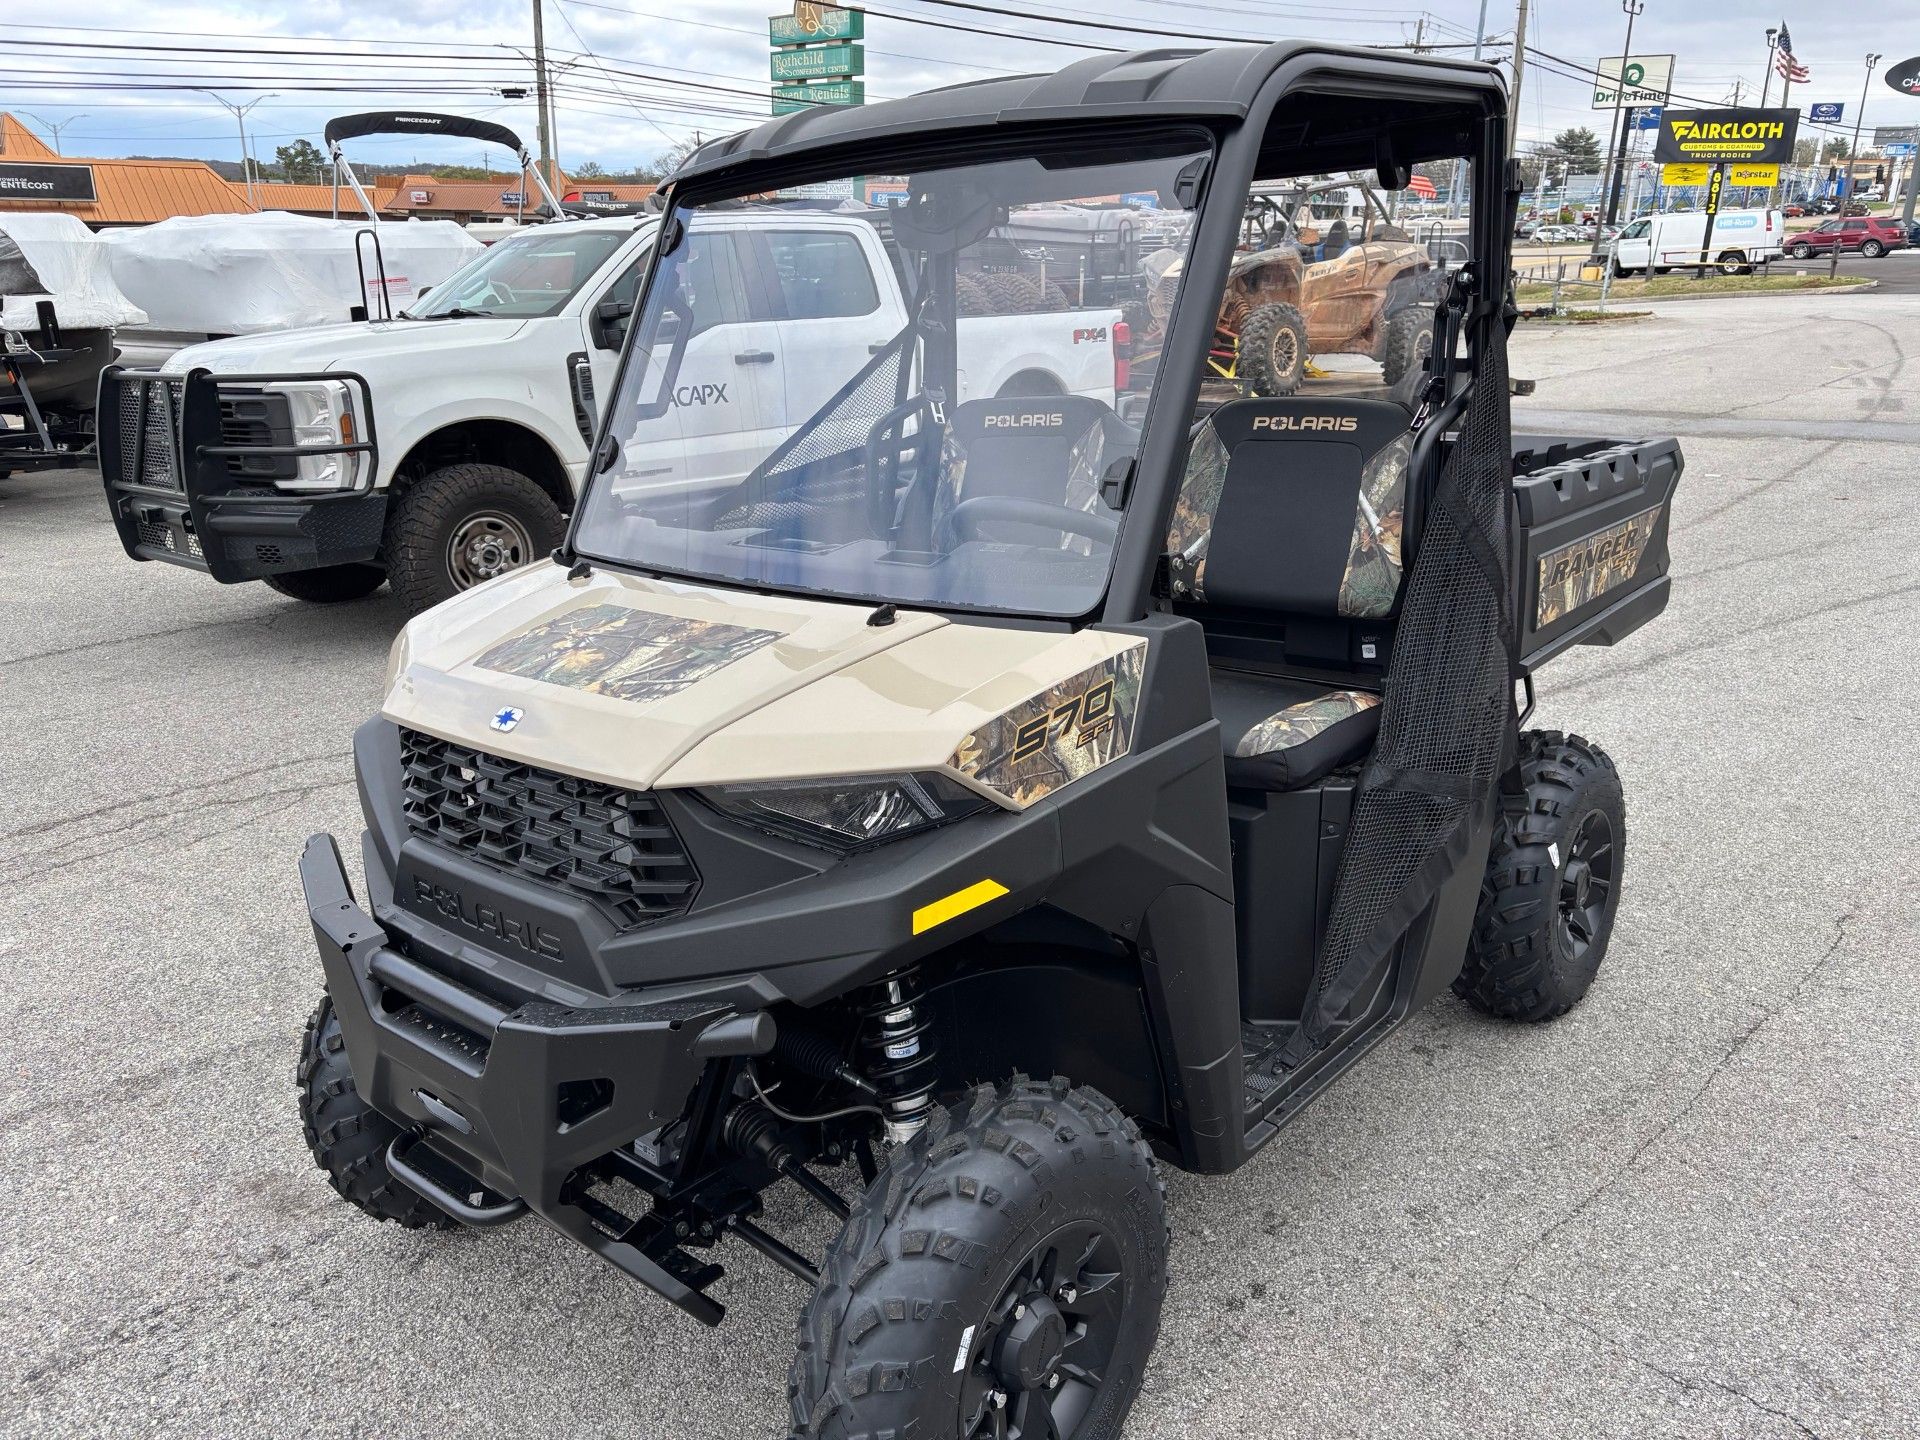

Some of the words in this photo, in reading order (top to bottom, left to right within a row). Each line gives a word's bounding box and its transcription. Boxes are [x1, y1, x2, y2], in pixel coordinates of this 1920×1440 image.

[773, 51, 824, 72] Rothchild
[793, 67, 826, 76] CONFERENCE
[828, 65, 848, 73] CENTER
[808, 85, 849, 101] Rentals
[1671, 121, 1784, 141] FAIRCLOTH
[1706, 172, 1722, 214] 8812
[585, 201, 629, 211] Ranger
[1073, 327, 1106, 344] FX4
[984, 413, 1063, 428] POLARIS
[1252, 416, 1358, 432] POLARIS
[1550, 526, 1639, 588] RANGER
[1010, 678, 1116, 766] 570
[1076, 715, 1116, 749] EFI
[412, 874, 565, 963] POLARIS
